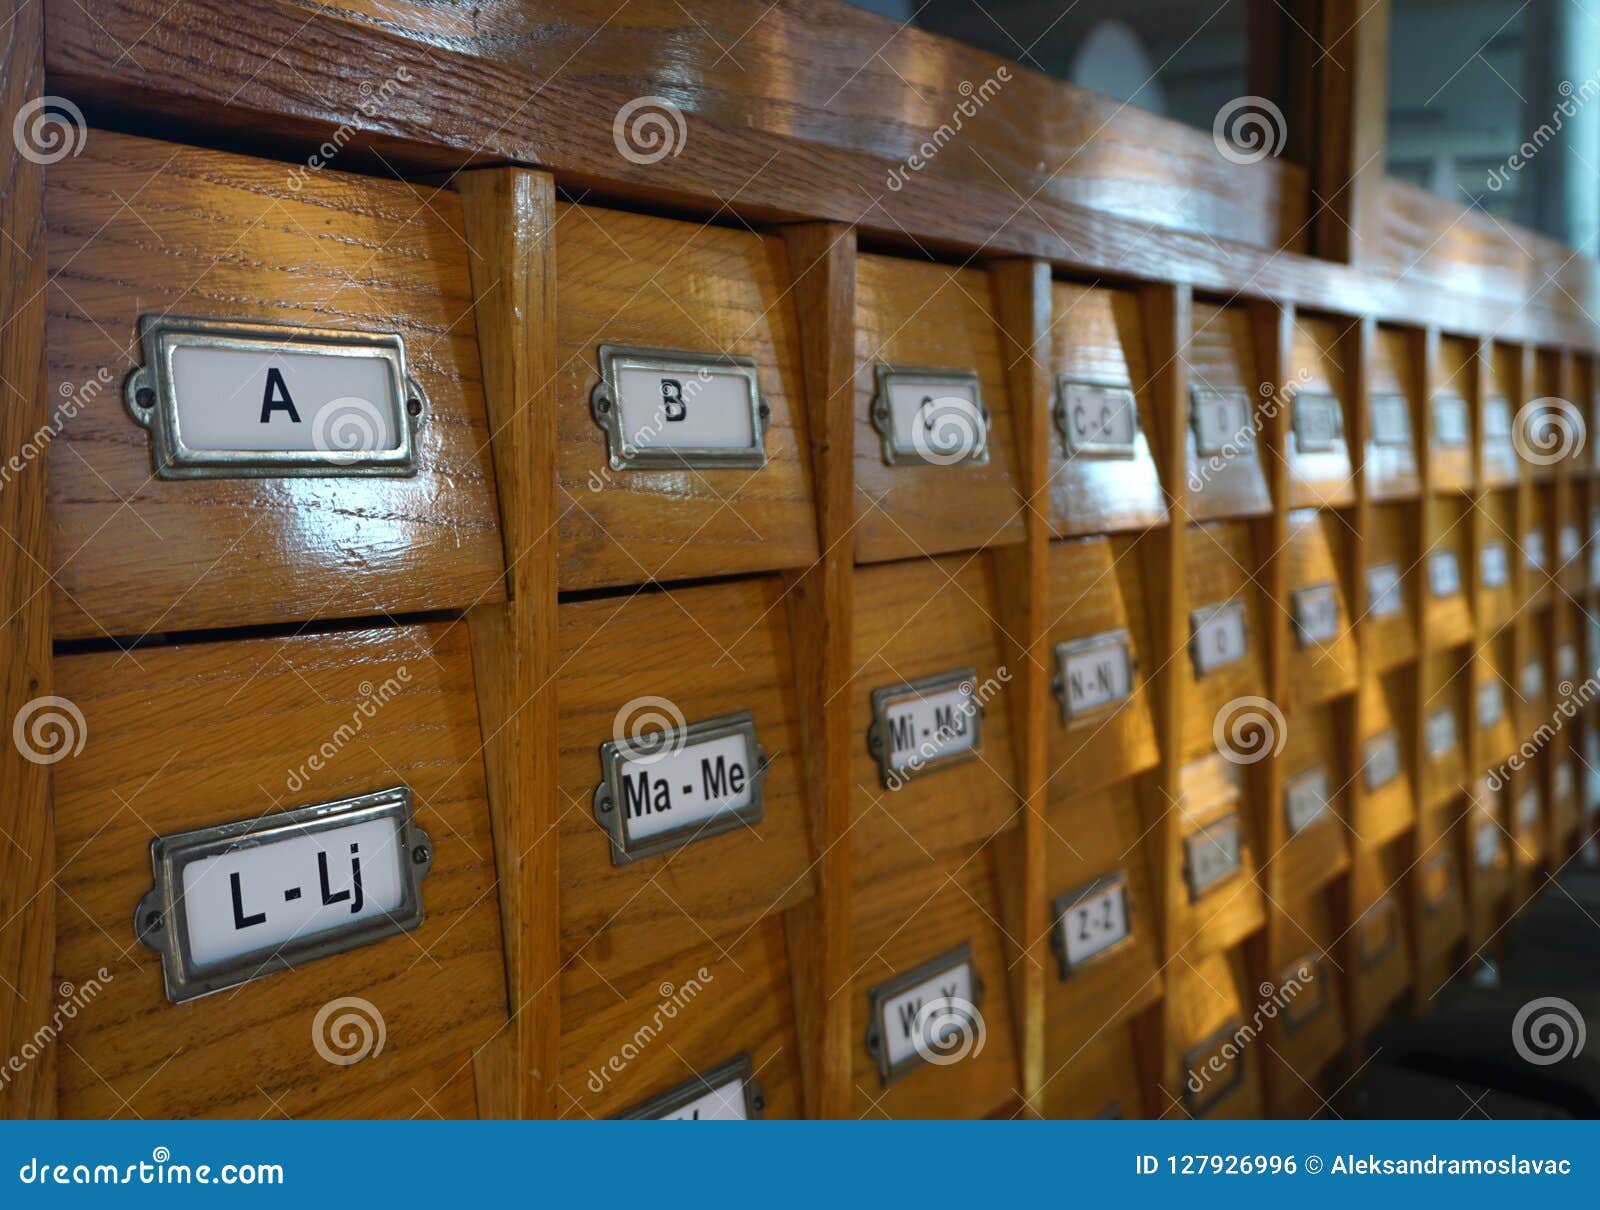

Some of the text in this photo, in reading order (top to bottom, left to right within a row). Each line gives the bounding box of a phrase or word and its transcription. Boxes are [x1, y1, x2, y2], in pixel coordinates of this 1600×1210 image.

[258, 368, 301, 423] A
[661, 379, 687, 422] B
[622, 770, 672, 819] Ma
[701, 755, 745, 801] Me
[230, 872, 266, 930] L
[317, 843, 364, 914] Lj
